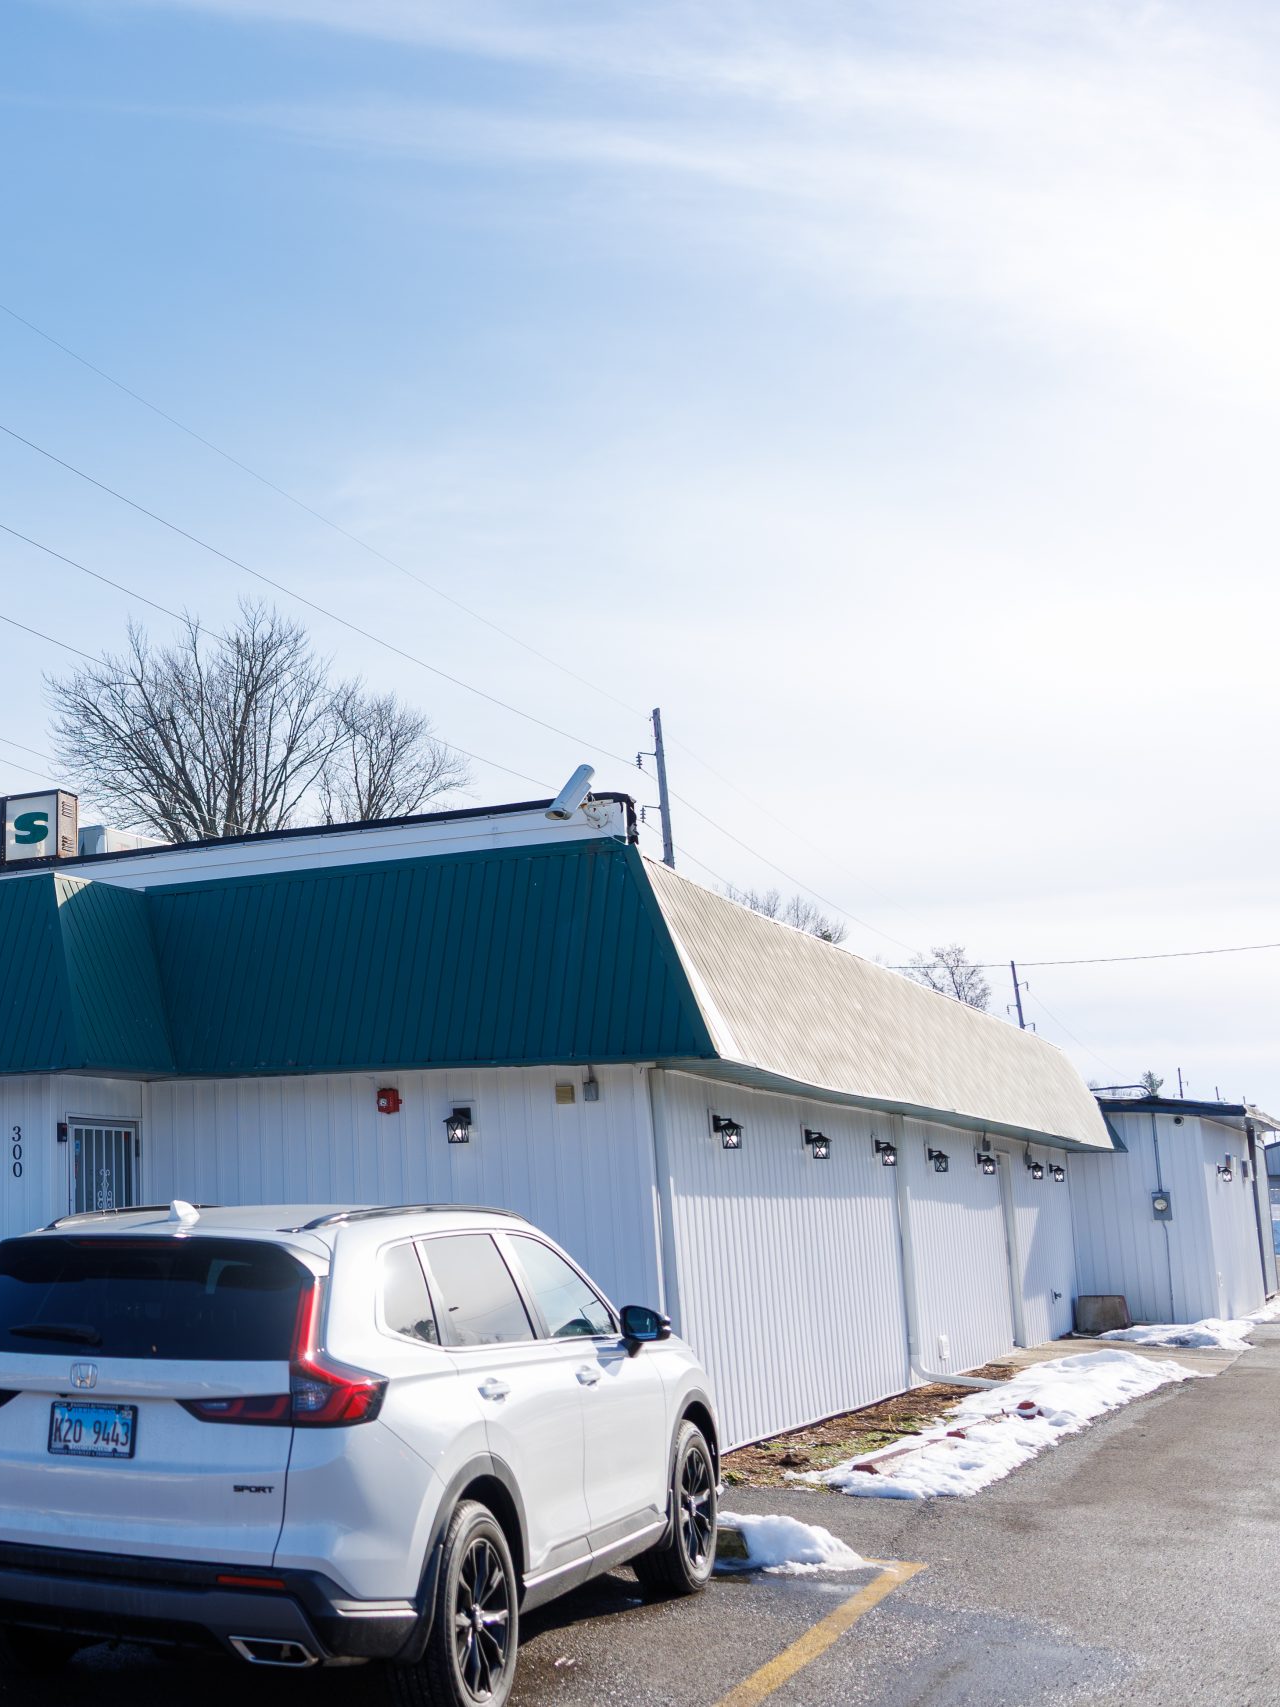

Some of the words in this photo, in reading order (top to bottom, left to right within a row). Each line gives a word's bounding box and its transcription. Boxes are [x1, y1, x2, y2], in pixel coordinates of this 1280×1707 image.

[12, 1126, 22, 1177] 300
[53, 1418, 82, 1443] K20
[93, 1420, 129, 1446] 9443
[233, 1484, 275, 1494] SPORT
